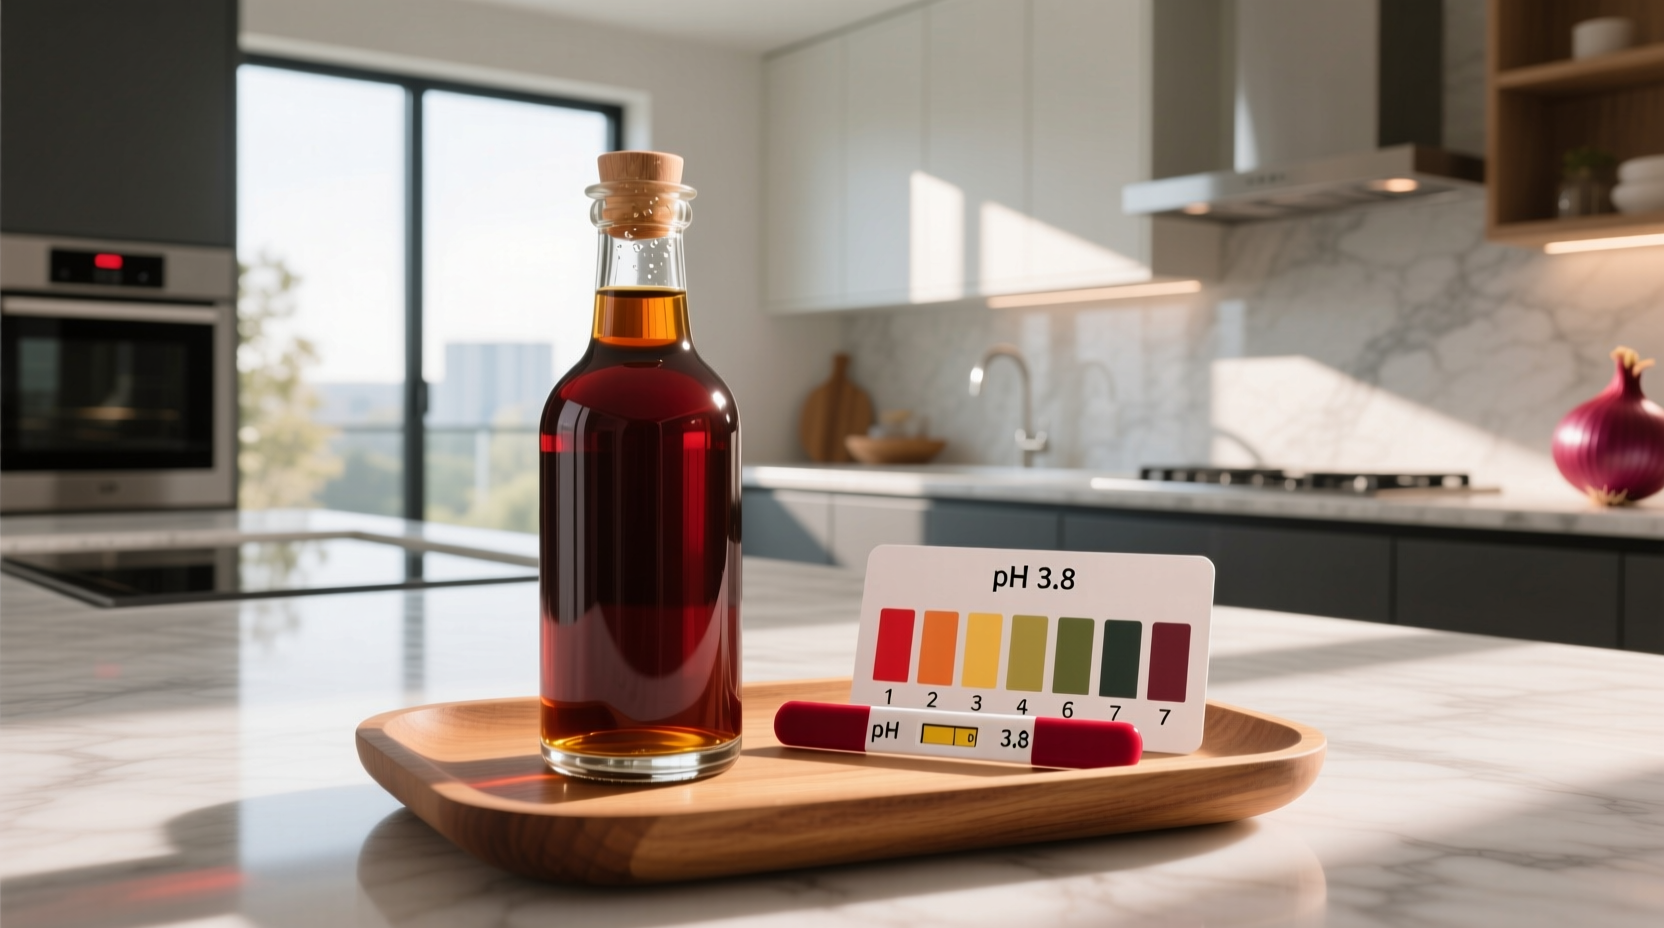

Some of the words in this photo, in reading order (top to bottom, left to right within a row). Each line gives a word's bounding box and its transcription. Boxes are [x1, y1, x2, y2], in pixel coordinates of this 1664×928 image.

[992, 565, 1029, 593] pH
[1037, 566, 1076, 591] 3.8
[884, 688, 893, 705] 1
[926, 692, 938, 708] 2
[970, 695, 982, 712] 3
[1016, 698, 1028, 715] 4
[1062, 701, 1074, 719] 6
[1109, 705, 1122, 721] 7
[1158, 709, 1172, 726] 7
[871, 720, 900, 743] pH
[1000, 729, 1030, 749] 3.8
